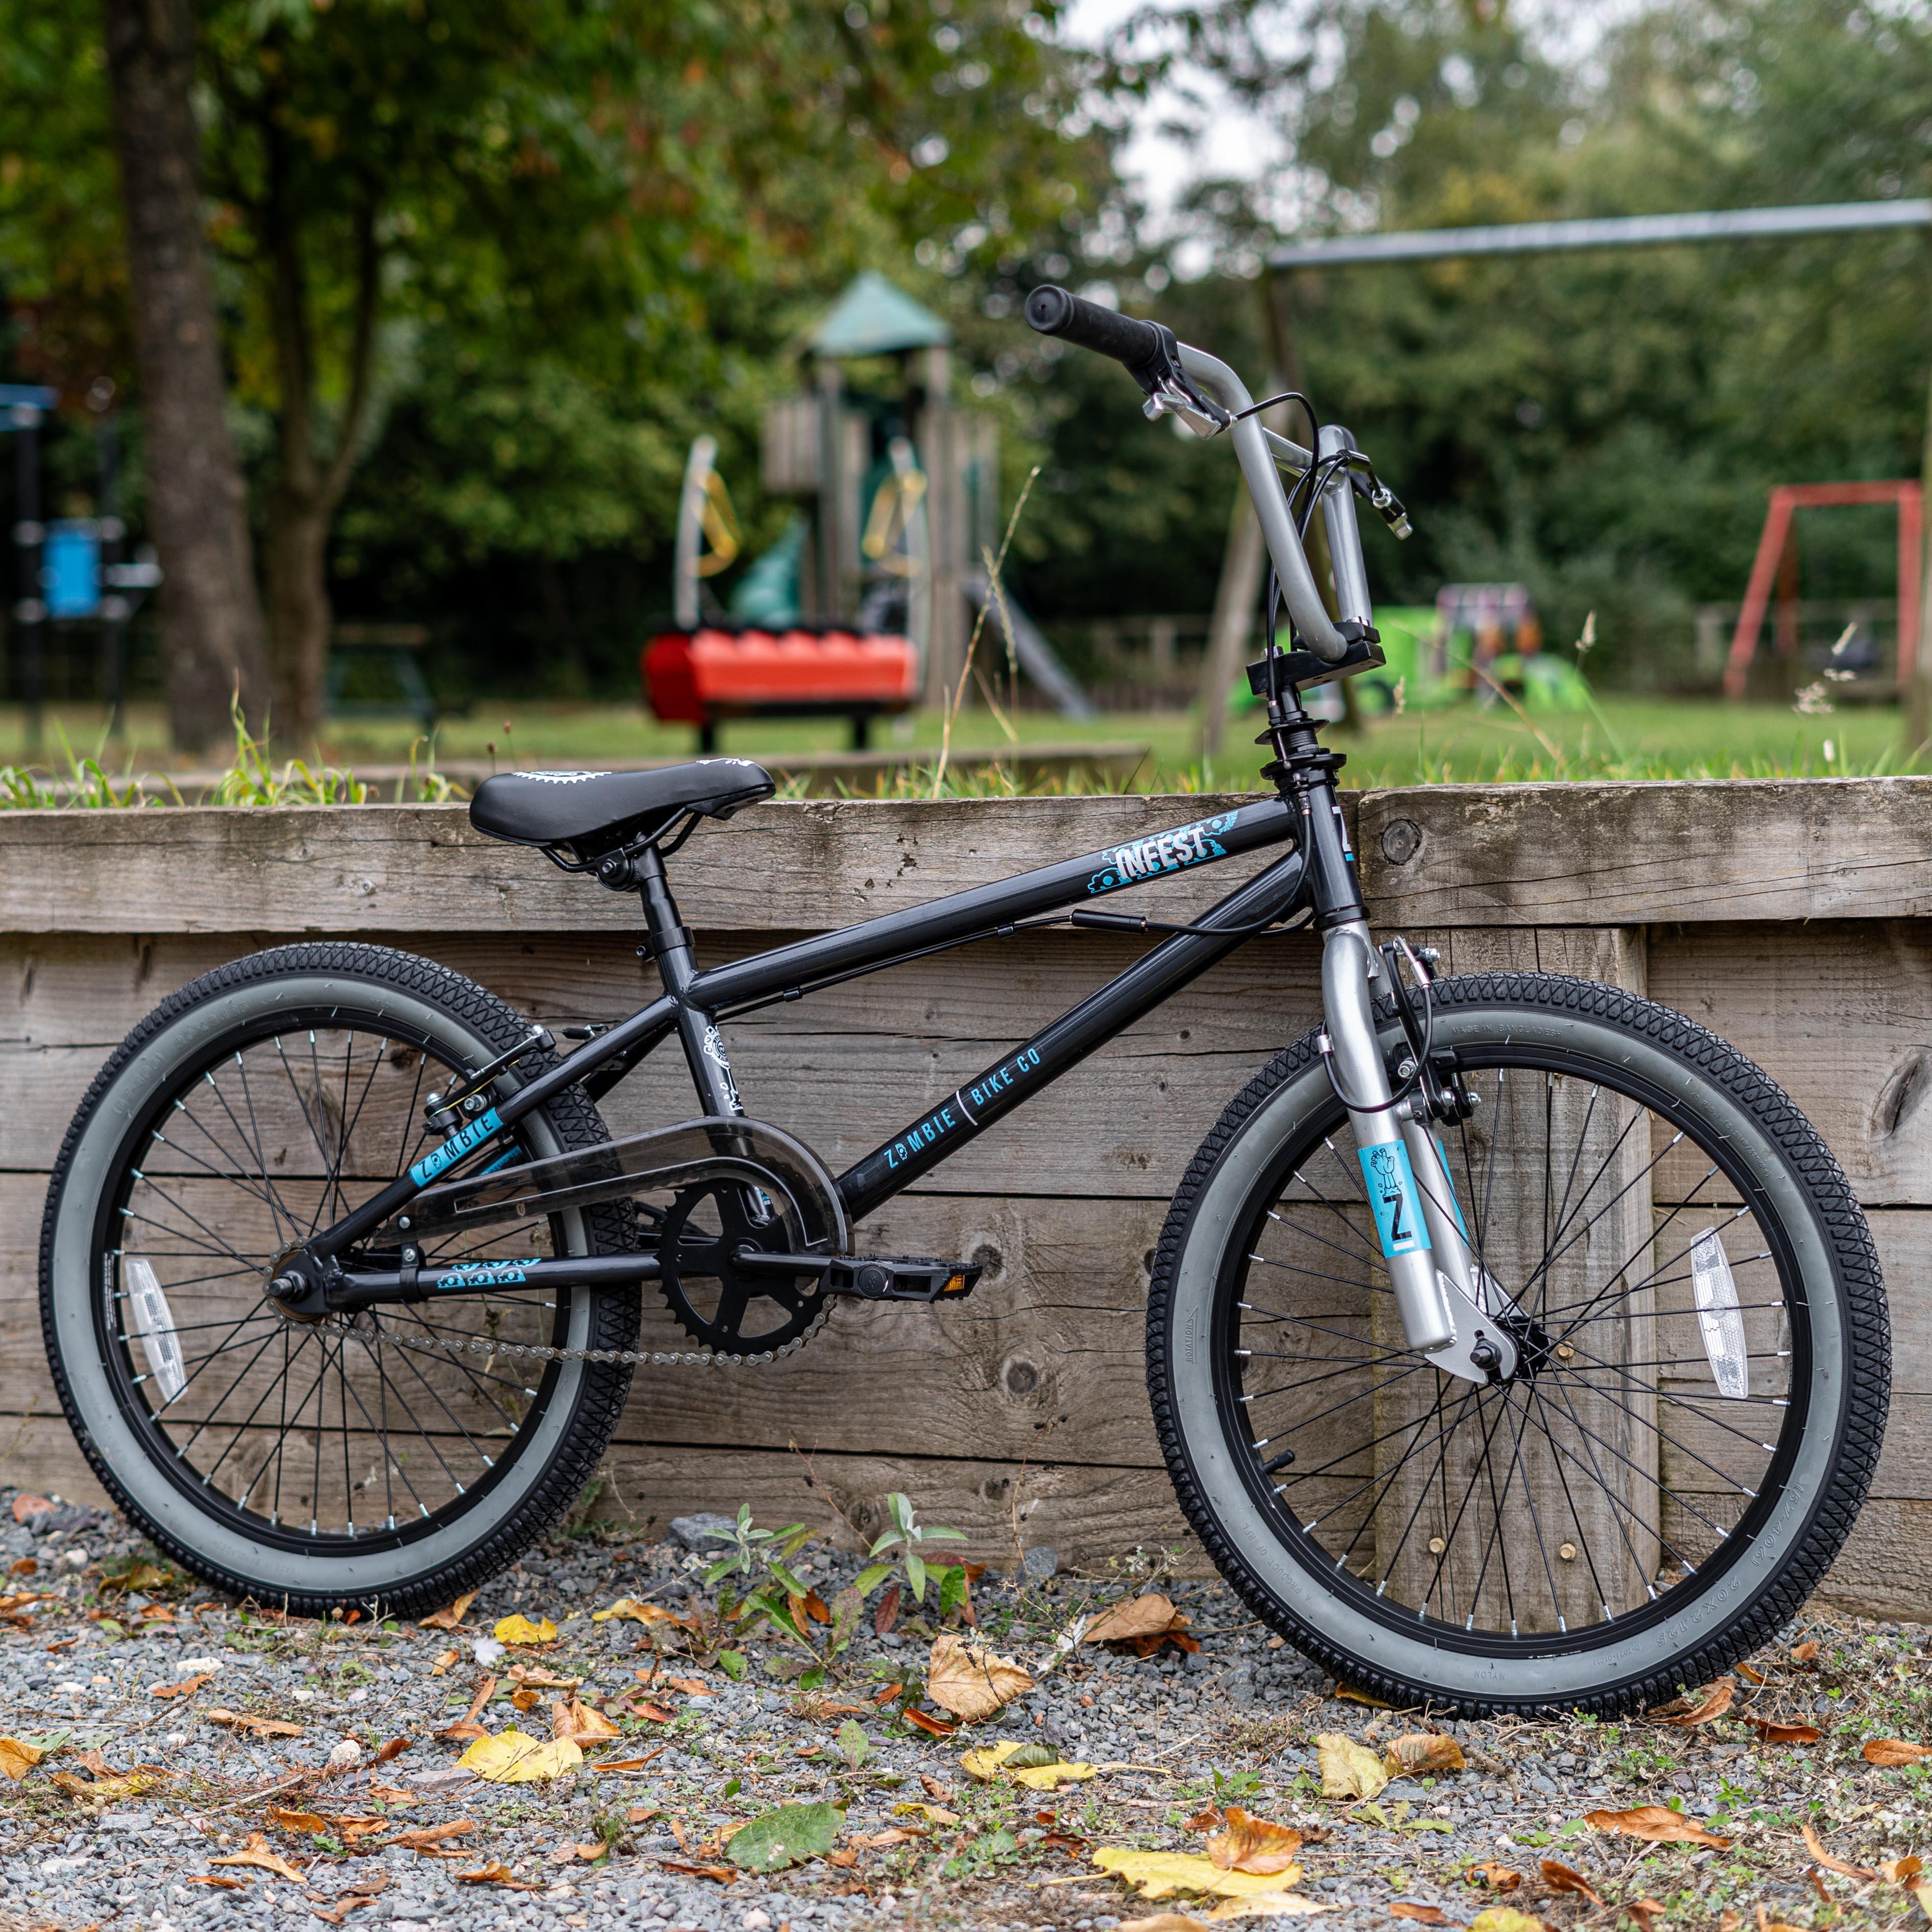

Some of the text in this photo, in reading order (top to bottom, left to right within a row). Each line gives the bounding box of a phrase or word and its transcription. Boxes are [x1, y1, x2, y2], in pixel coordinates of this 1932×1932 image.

[1115, 827, 1205, 879] INFEST
[1451, 1024, 1563, 1038] MADE IN BANGLADESH
[971, 1067, 1014, 1106] BIKE
[1016, 1048, 1040, 1072] CO
[1185, 1323, 1193, 1363] ROTATION
[1750, 1484, 1804, 1565] (57-406)
[1256, 1544, 1268, 1556] OF
[1267, 1559, 1303, 1595] PRODUCT
[1304, 1593, 1312, 1602] A
[1655, 1576, 1741, 1647] 20X2.125
[1473, 1669, 1506, 1681] NYLON
